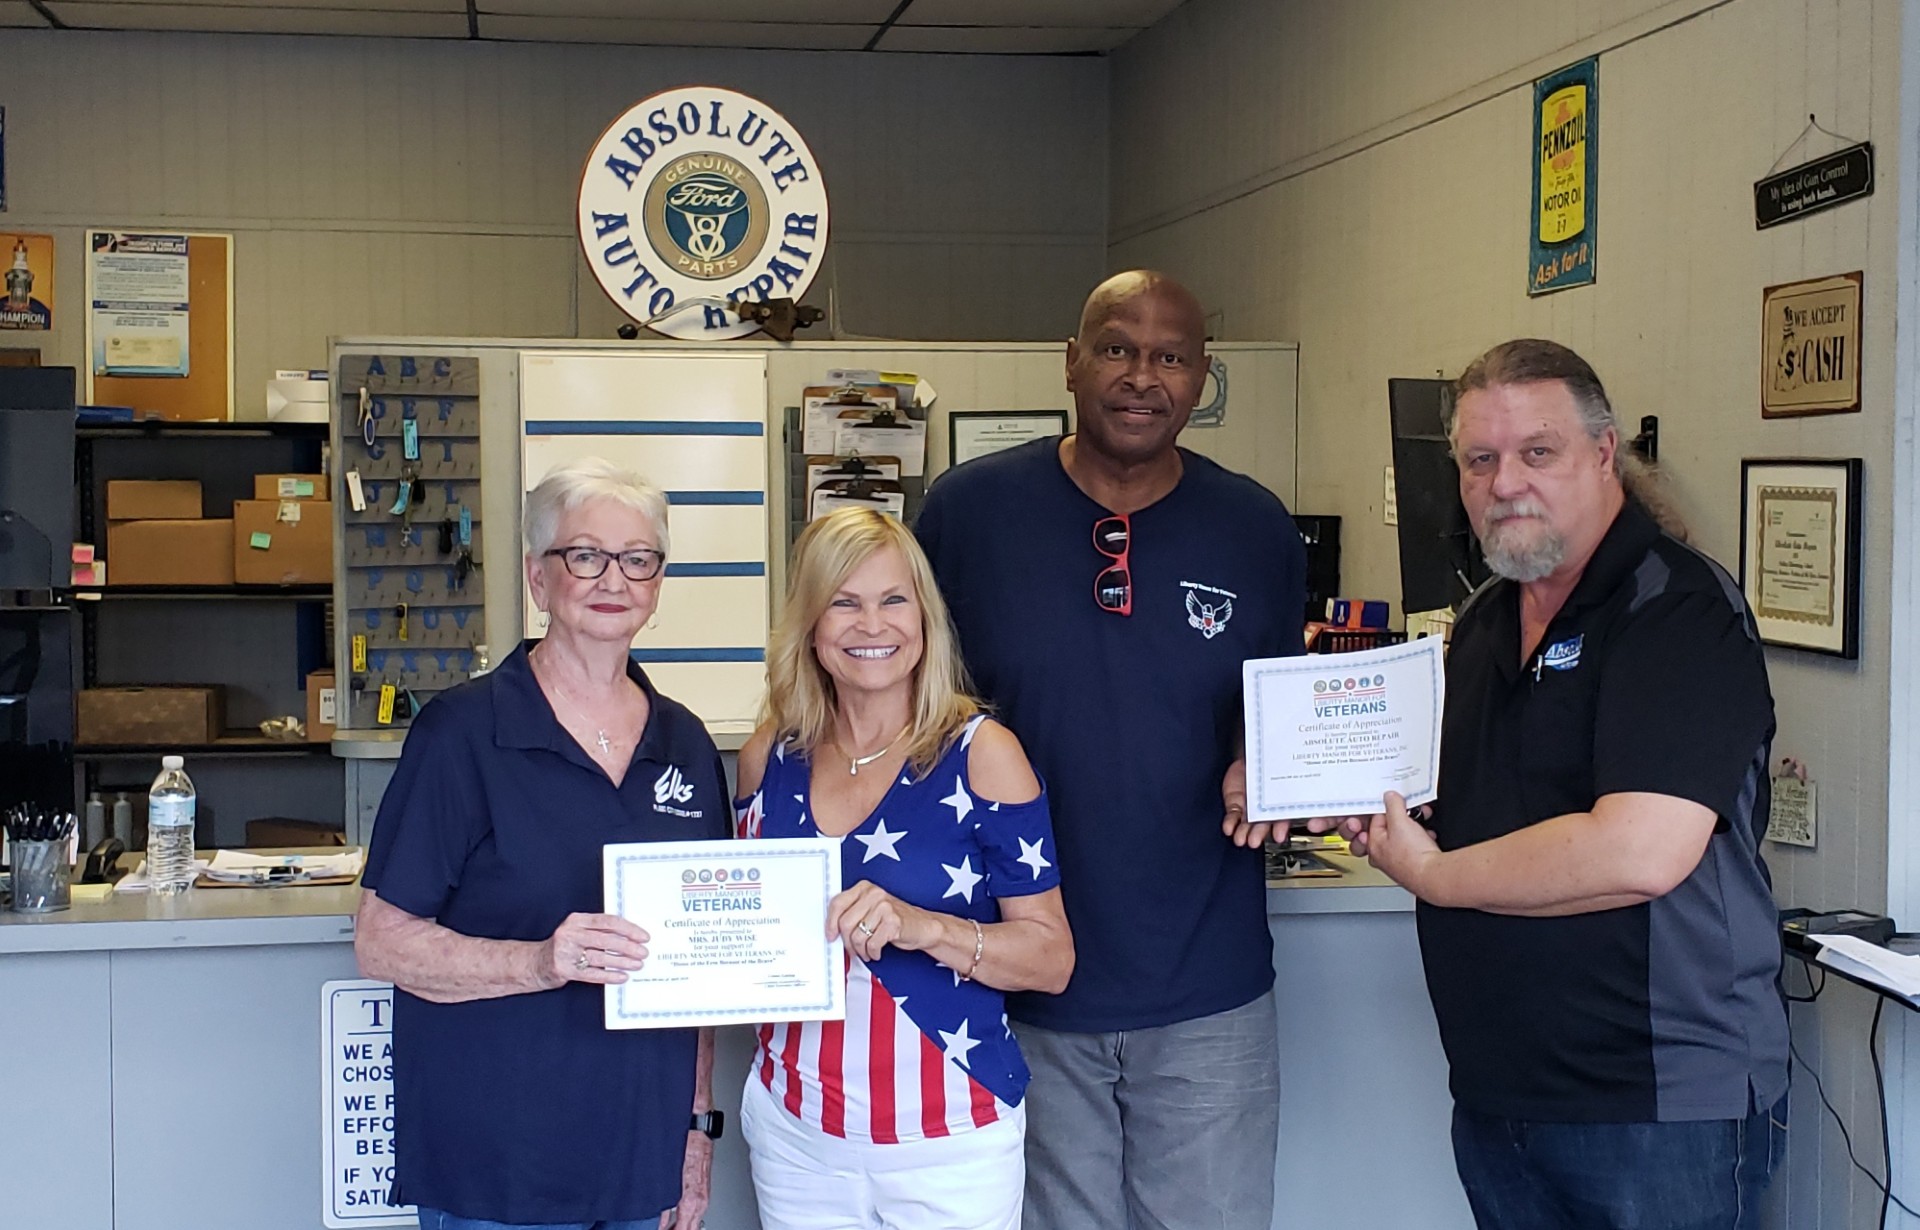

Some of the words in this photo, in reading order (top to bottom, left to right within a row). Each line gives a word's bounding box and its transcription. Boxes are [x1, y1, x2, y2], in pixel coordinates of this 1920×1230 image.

[605, 101, 809, 194] ABSOLUTE
[1543, 113, 1585, 163] PENNZOIL
[665, 157, 746, 182] GENUINE
[1770, 186, 1780, 203] My
[1781, 181, 1795, 196] idea
[1796, 175, 1803, 191] of
[1803, 174, 1819, 188] Gun
[1820, 160, 1848, 182] Control
[671, 182, 740, 208] Ford
[1544, 191, 1570, 212] MOTOR
[1781, 202, 1787, 213] is
[1787, 198, 1803, 210] using
[1803, 191, 1816, 206] both
[592, 211, 675, 317] AUTO
[678, 256, 739, 275] PARTS
[1535, 257, 1559, 287] Ask
[1561, 250, 1578, 273] for
[1579, 243, 1587, 266] it
[0, 311, 45, 324] HAMPION
[1794, 310, 1807, 327] WE
[1809, 304, 1846, 326] ACCEPT
[367, 355, 386, 376] A
[399, 355, 417, 377] B
[434, 357, 452, 377] C
[1802, 336, 1845, 384] CASH
[370, 397, 386, 419] D
[402, 398, 417, 420] E
[438, 398, 454, 421] F
[442, 441, 453, 462] I
[367, 482, 381, 504] J
[444, 481, 459, 504] L
[365, 525, 386, 547] M
[367, 569, 384, 590] P
[365, 609, 381, 630] S
[452, 608, 471, 629] V
[368, 651, 387, 672] W
[402, 651, 417, 672] X
[433, 651, 452, 672] Y
[1315, 700, 1387, 718] VETERANS
[1298, 722, 1340, 733] Certificate
[1342, 721, 1351, 729] of
[1353, 717, 1402, 730] Appreciation
[1303, 738, 1344, 747] ABSOLUTE
[1348, 735, 1370, 743] AUTO
[1371, 732, 1399, 741] REPAIR
[1292, 752, 1320, 760] LIBERTY
[1322, 750, 1347, 758] MANOR
[654, 763, 694, 804] Elks
[682, 897, 762, 912] VETERANS
[664, 918, 710, 928] Certificate
[712, 918, 722, 926] of
[725, 917, 780, 928] Appreciation
[711, 935, 732, 943] JUDY
[735, 934, 757, 942] WISE
[721, 943, 744, 951] support
[658, 952, 687, 960] LIBERTY
[690, 951, 717, 959] MANOR
[361, 999, 392, 1027] T
[343, 1044, 373, 1060] WE
[381, 1043, 393, 1059] A
[342, 1065, 393, 1082] CHOS
[343, 1095, 376, 1111] WE
[343, 1116, 395, 1133] EFFO
[356, 1138, 395, 1155] BES
[344, 1168, 360, 1183] IF
[371, 1166, 396, 1183] YO
[345, 1189, 387, 1206] SATI
